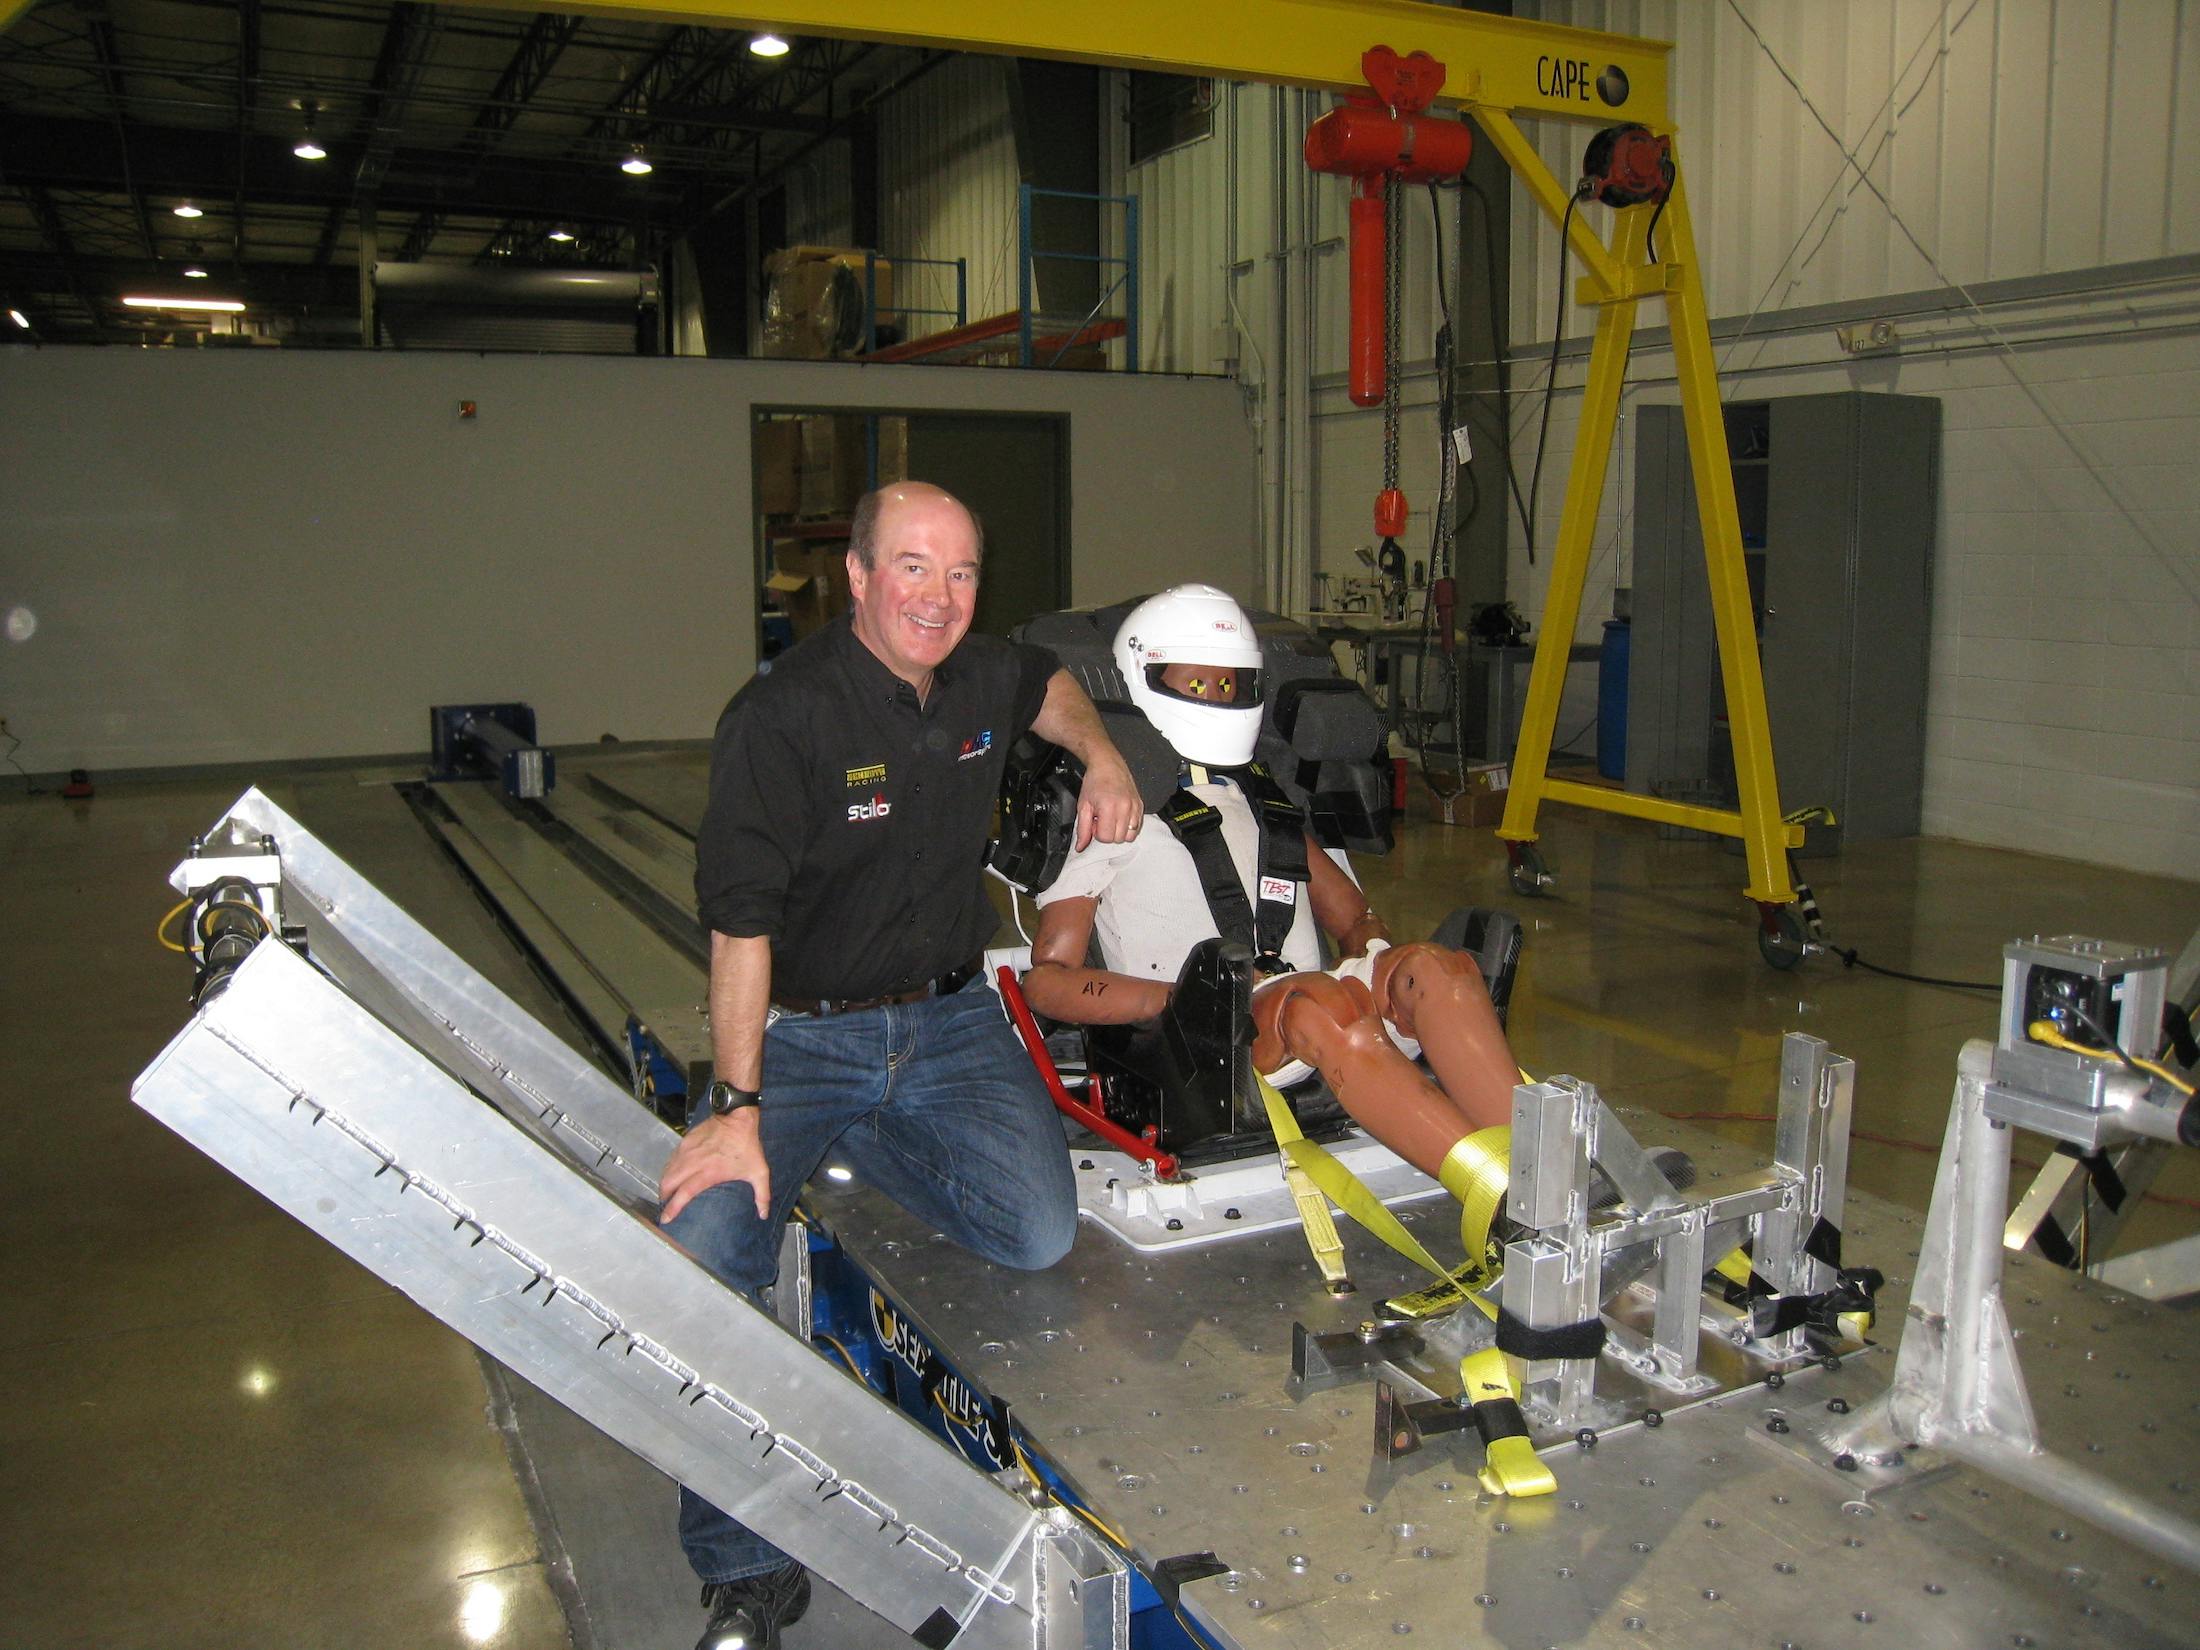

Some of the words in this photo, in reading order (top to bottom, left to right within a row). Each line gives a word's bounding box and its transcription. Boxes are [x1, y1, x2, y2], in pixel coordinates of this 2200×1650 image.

[1537, 55, 1590, 101] CAPE
[846, 776, 887, 788] RACING
[847, 797, 890, 821] Stilo
[1263, 880, 1291, 894] TEST
[1082, 981, 1109, 996] A7
